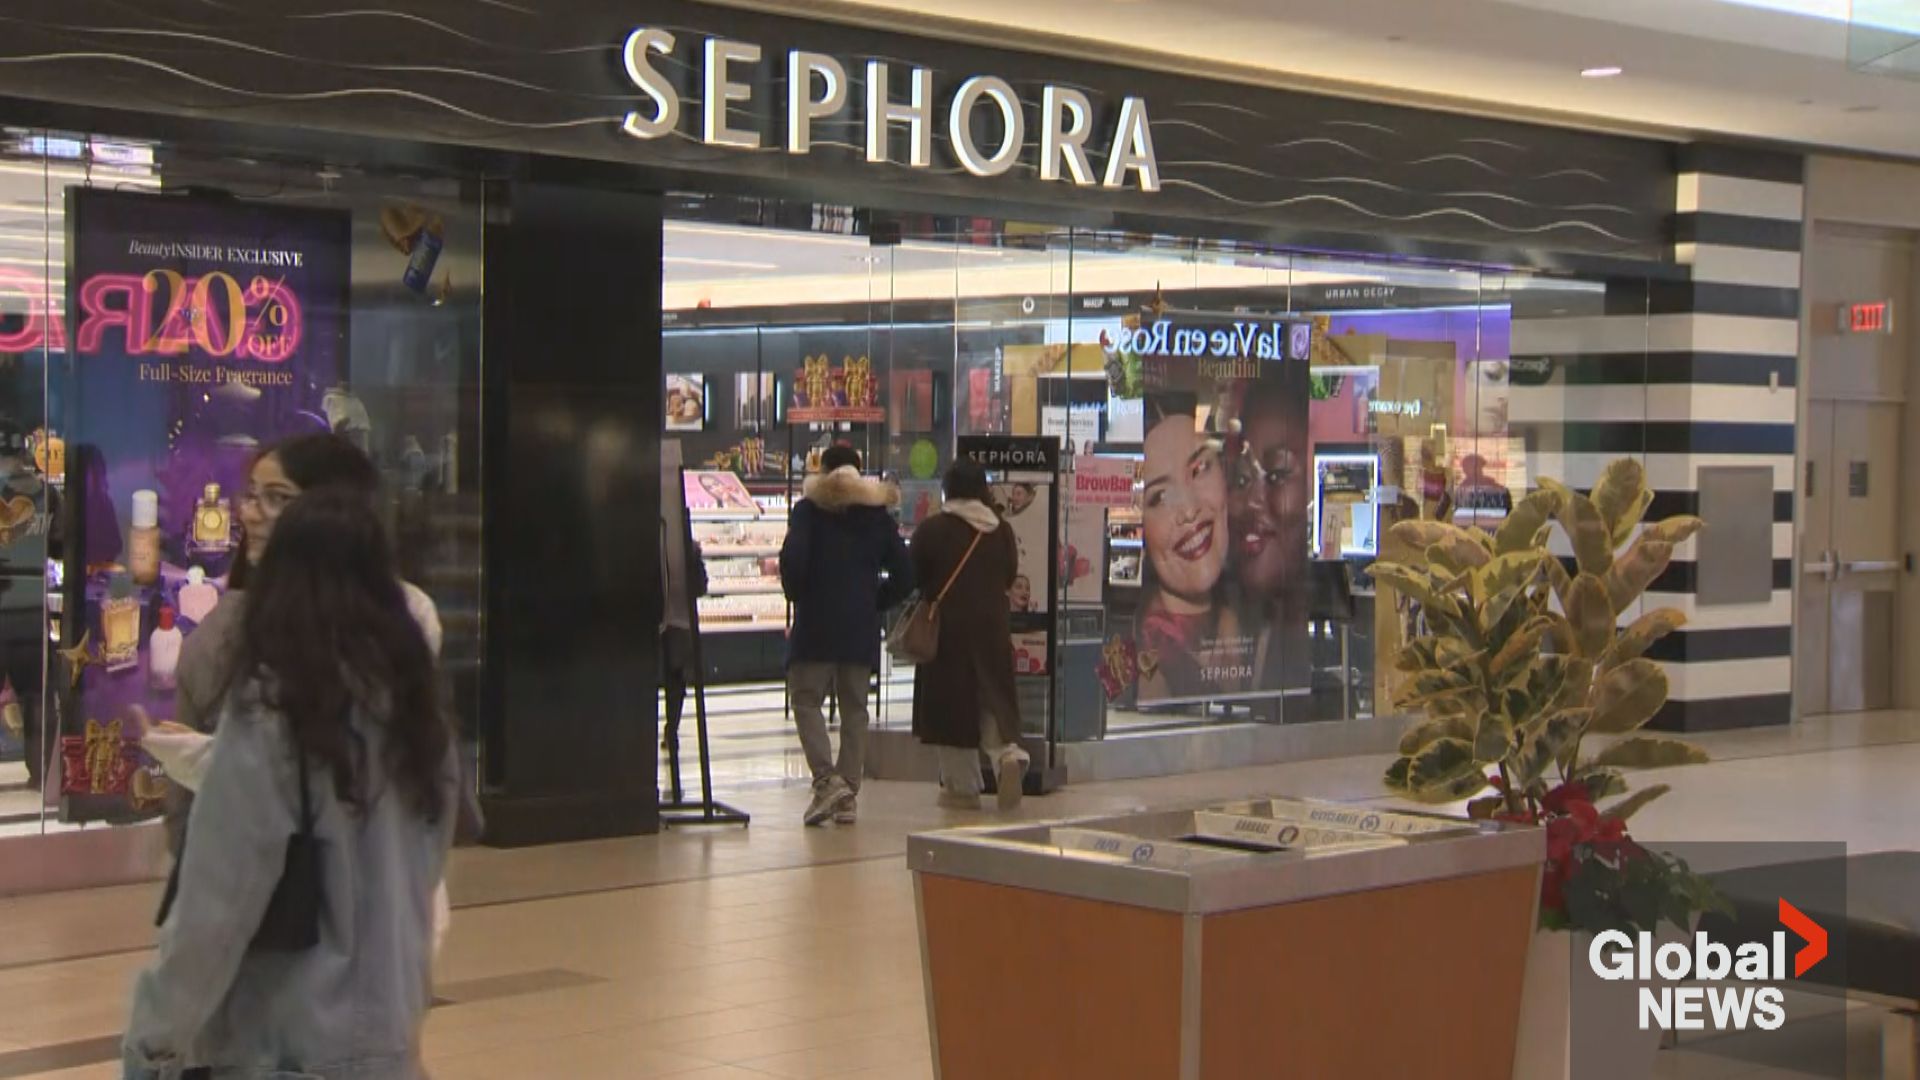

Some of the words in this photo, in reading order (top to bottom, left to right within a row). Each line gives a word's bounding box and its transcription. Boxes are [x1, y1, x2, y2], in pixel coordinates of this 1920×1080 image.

[622, 27, 1161, 192] SEPHORA
[227, 247, 303, 267] EXCLUSIVE
[1325, 288, 1359, 299] URBAN
[142, 268, 288, 356] 20%
[1850, 303, 1885, 331] EXIT
[140, 363, 211, 383] Full-Size
[215, 365, 293, 385] Fragrance
[1198, 357, 1261, 379] Beautiful
[968, 450, 1047, 464] SEPHORA
[1076, 475, 1132, 492] BrowBar
[1200, 665, 1252, 681] SEPHORA
